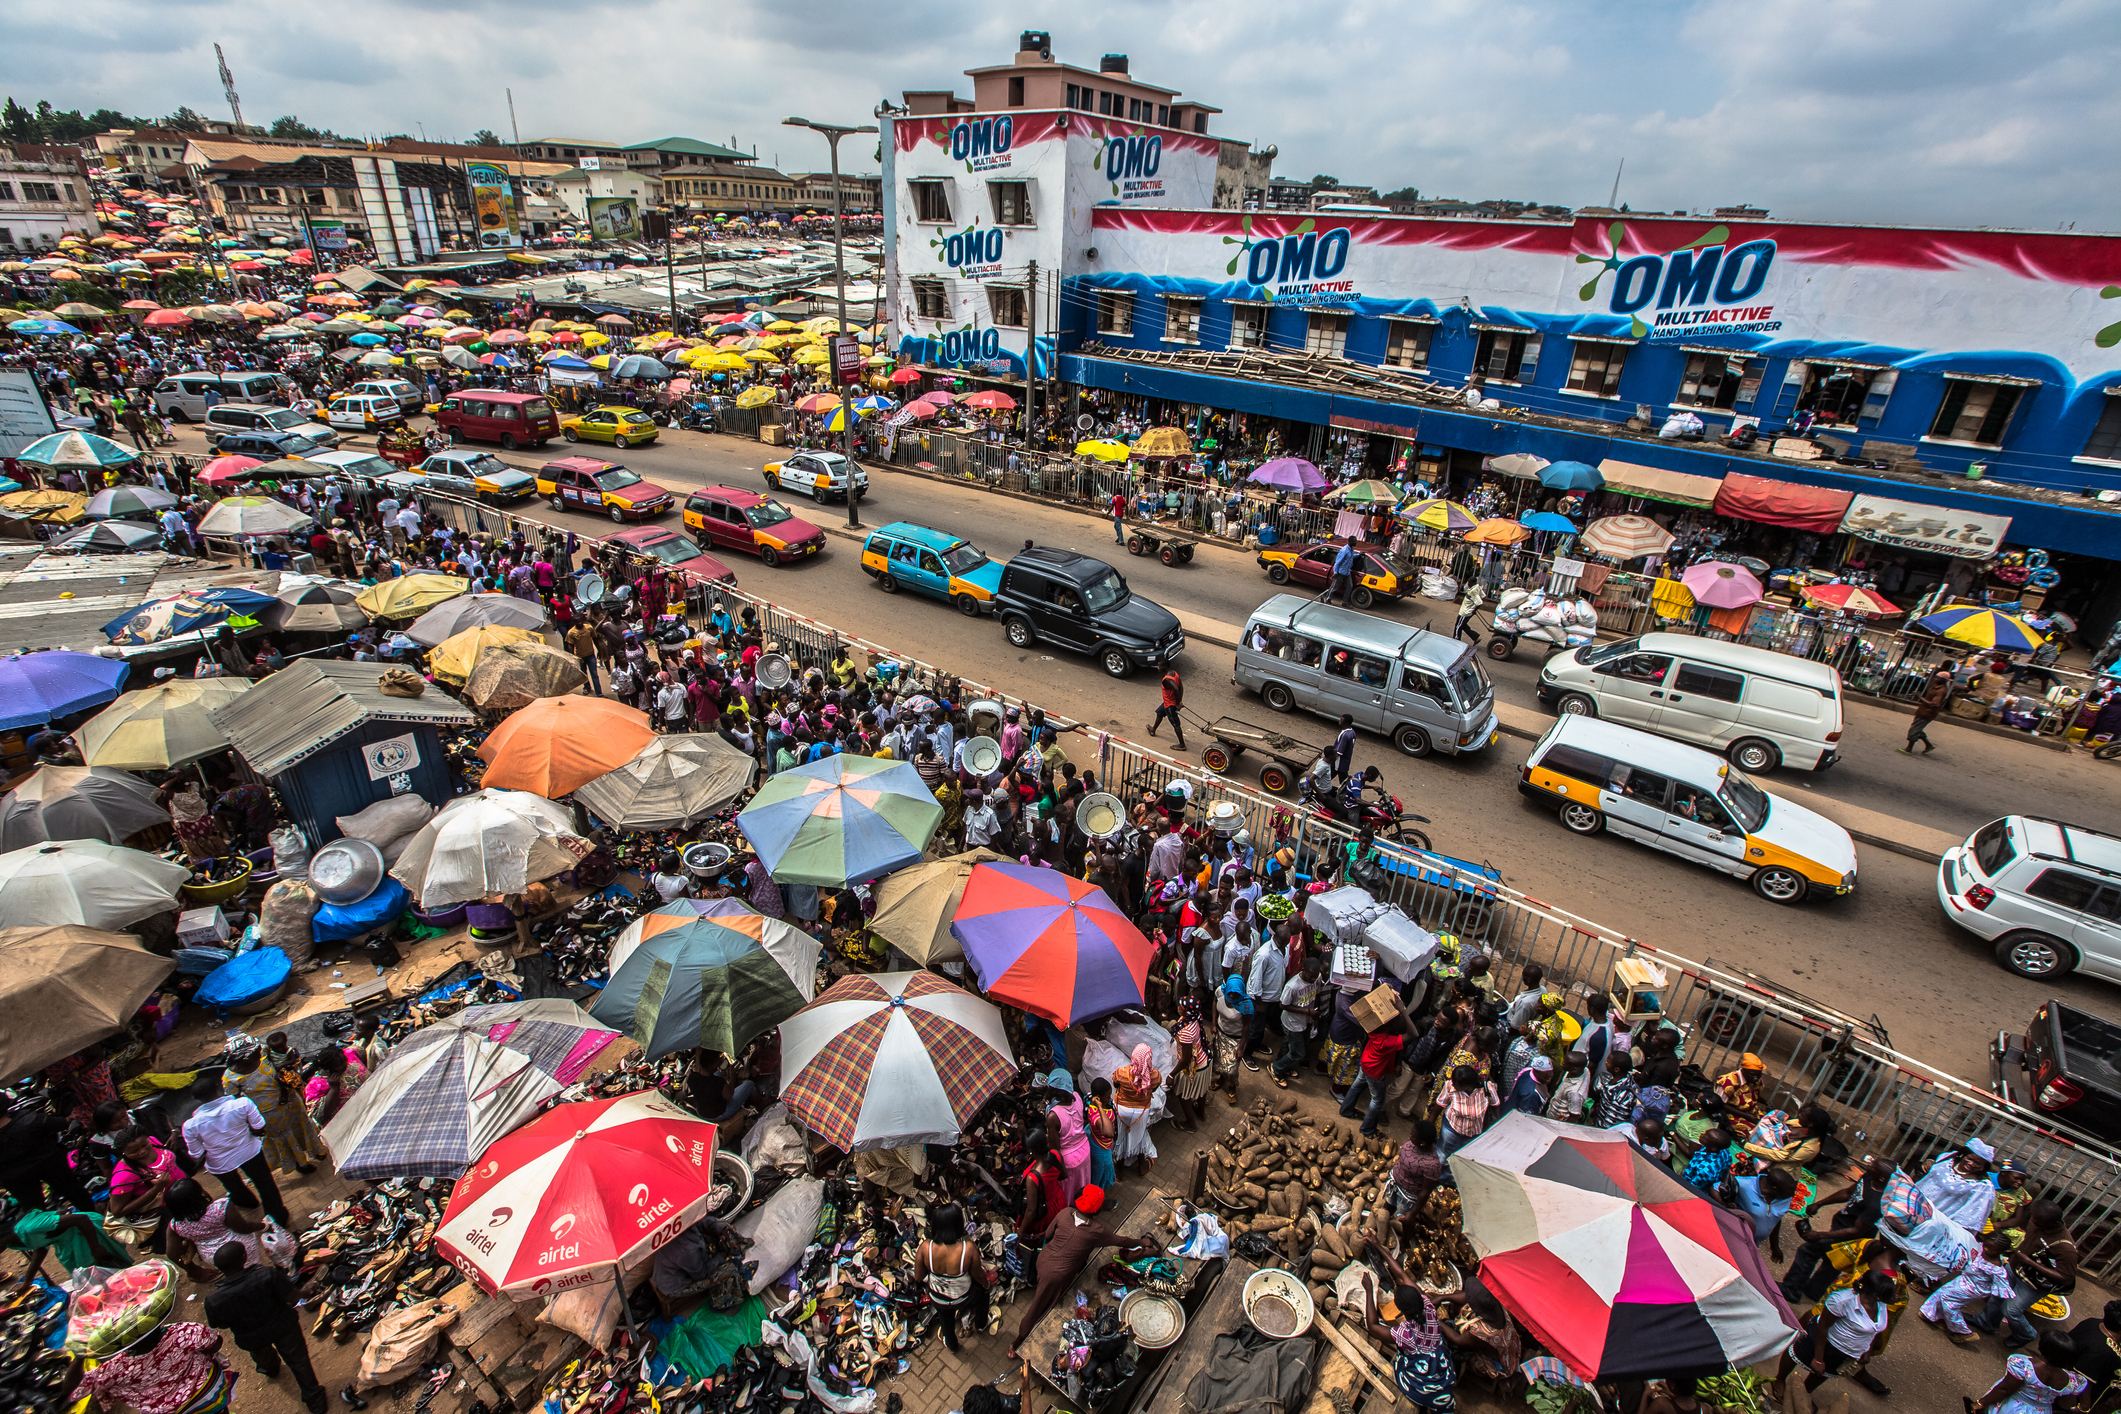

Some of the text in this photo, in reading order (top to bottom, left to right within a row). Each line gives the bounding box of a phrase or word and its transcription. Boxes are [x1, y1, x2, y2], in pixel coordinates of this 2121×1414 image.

[952, 115, 1013, 161] OMO
[973, 153, 1012, 167] MULTIACTIVE
[1106, 135, 1163, 182] OMO
[471, 171, 508, 184] HEAVEN
[1123, 180, 1163, 191] MULTIACTIVE
[947, 228, 1003, 268] OMO
[1246, 227, 1351, 287] OMO
[966, 264, 1002, 274] MULTIACTIVE
[1609, 238, 1778, 315] OMO
[1276, 292, 1362, 306] HAND WASHING POWDER
[1278, 280, 1354, 296] MULTIACTIVE
[1654, 305, 1774, 327] MULTIACTIVE
[1651, 321, 1783, 339] HAND WASHING POWDER
[839, 345, 858, 354] DOUBLE
[945, 327, 1000, 363] OMO
[840, 353, 858, 362] BONUS
[1903, 539, 1930, 549] COLD
[374, 713, 468, 724] METRO MHIS
[285, 718, 364, 766] SUBIN SUB
[689, 1139, 705, 1166] airtel
[636, 1198, 674, 1229] airtel
[465, 1229, 497, 1257] airtel
[651, 1215, 683, 1250] 026
[538, 1241, 580, 1266] airtel
[455, 1255, 480, 1282] 026
[557, 1271, 595, 1288] airtel
